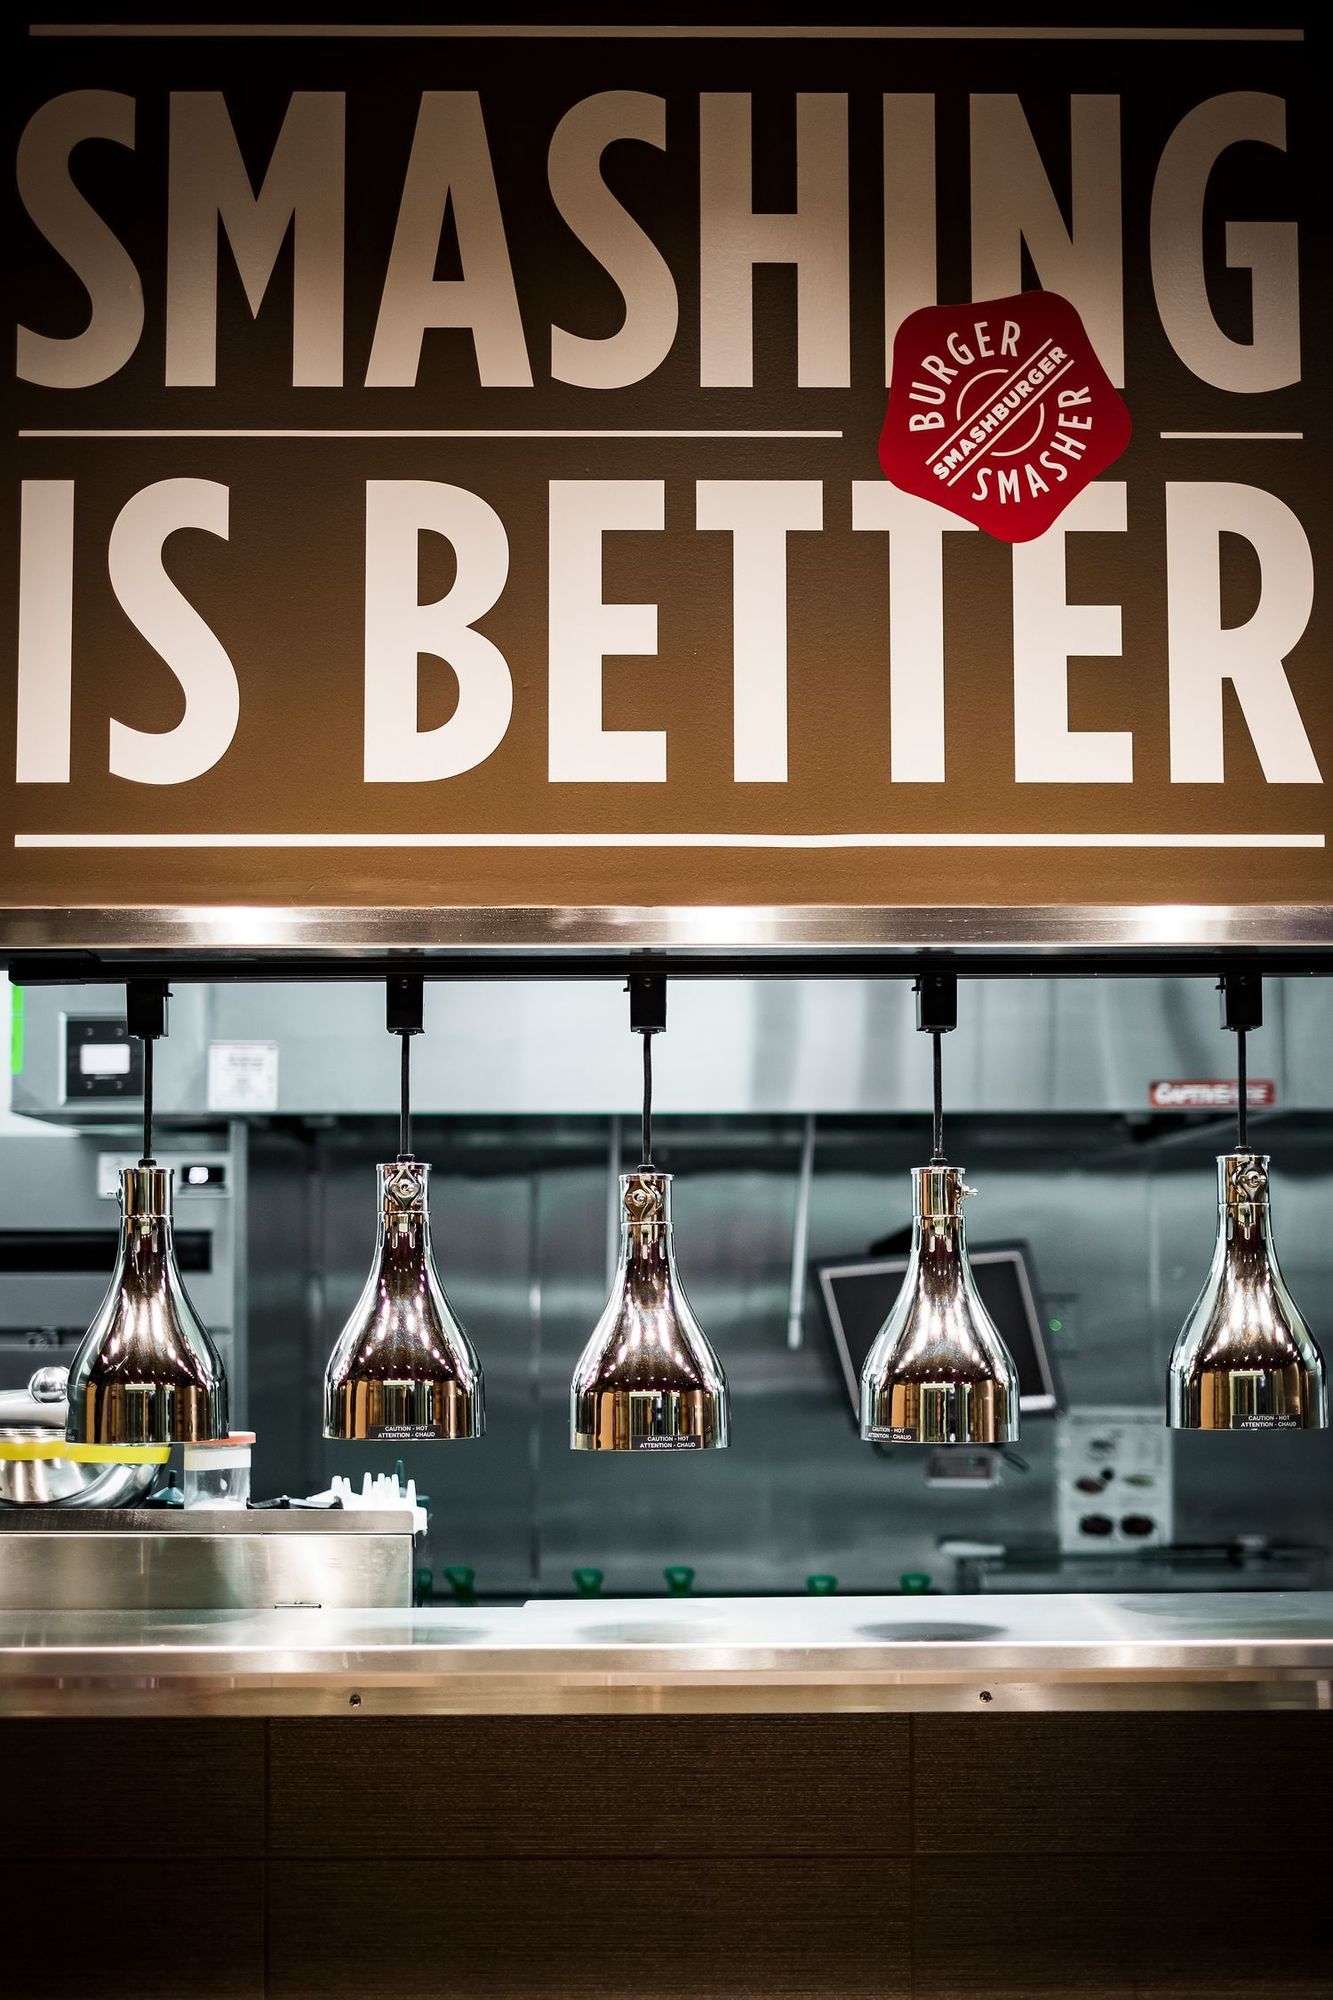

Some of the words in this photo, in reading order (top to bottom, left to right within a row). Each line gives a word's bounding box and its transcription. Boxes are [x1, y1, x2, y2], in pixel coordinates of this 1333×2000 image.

[15, 89, 1302, 393] SMASHING
[908, 320, 1022, 432] BURGER
[932, 345, 1068, 480] SMASHBURGER
[971, 385, 1093, 504] SMASHER
[16, 478, 240, 785] IS
[364, 480, 1323, 784] BETTER
